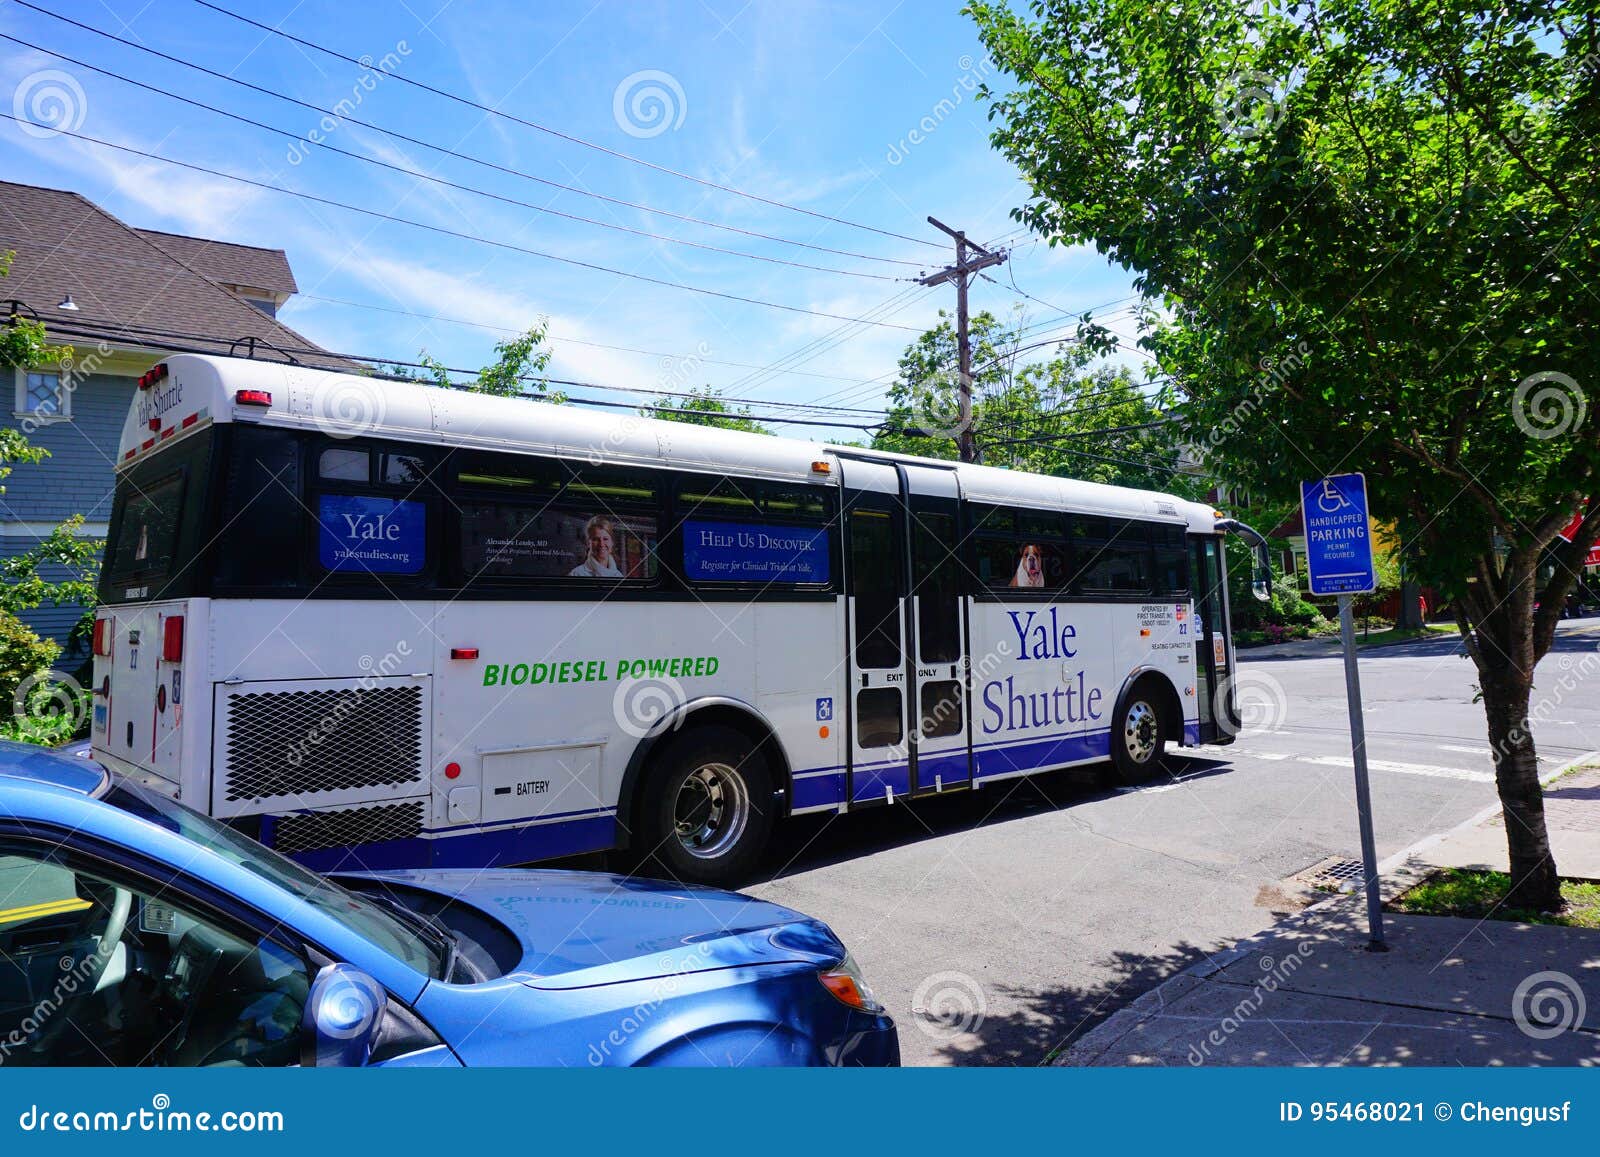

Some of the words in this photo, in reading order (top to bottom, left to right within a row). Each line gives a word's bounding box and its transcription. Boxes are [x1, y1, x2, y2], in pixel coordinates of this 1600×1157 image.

[341, 513, 401, 541] Yale
[1310, 514, 1363, 527] HANDICAPPED
[1311, 527, 1365, 542] PARKING
[1327, 543, 1350, 551] PERMIT
[334, 548, 410, 564] yalestudies.org
[1324, 551, 1355, 560] REQUIRED
[702, 560, 729, 572] Register
[729, 561, 741, 573] for
[742, 561, 768, 571] Clinical
[770, 562, 788, 572] Trials
[789, 563, 796, 572] at
[1007, 606, 1077, 660] Yale
[482, 660, 609, 687] BIODIESEL
[616, 656, 720, 681] POWERED
[886, 673, 904, 682] EXIT
[918, 669, 937, 677] ONLY
[981, 670, 1102, 734] Shuttle
[517, 780, 550, 796] BATTERY
